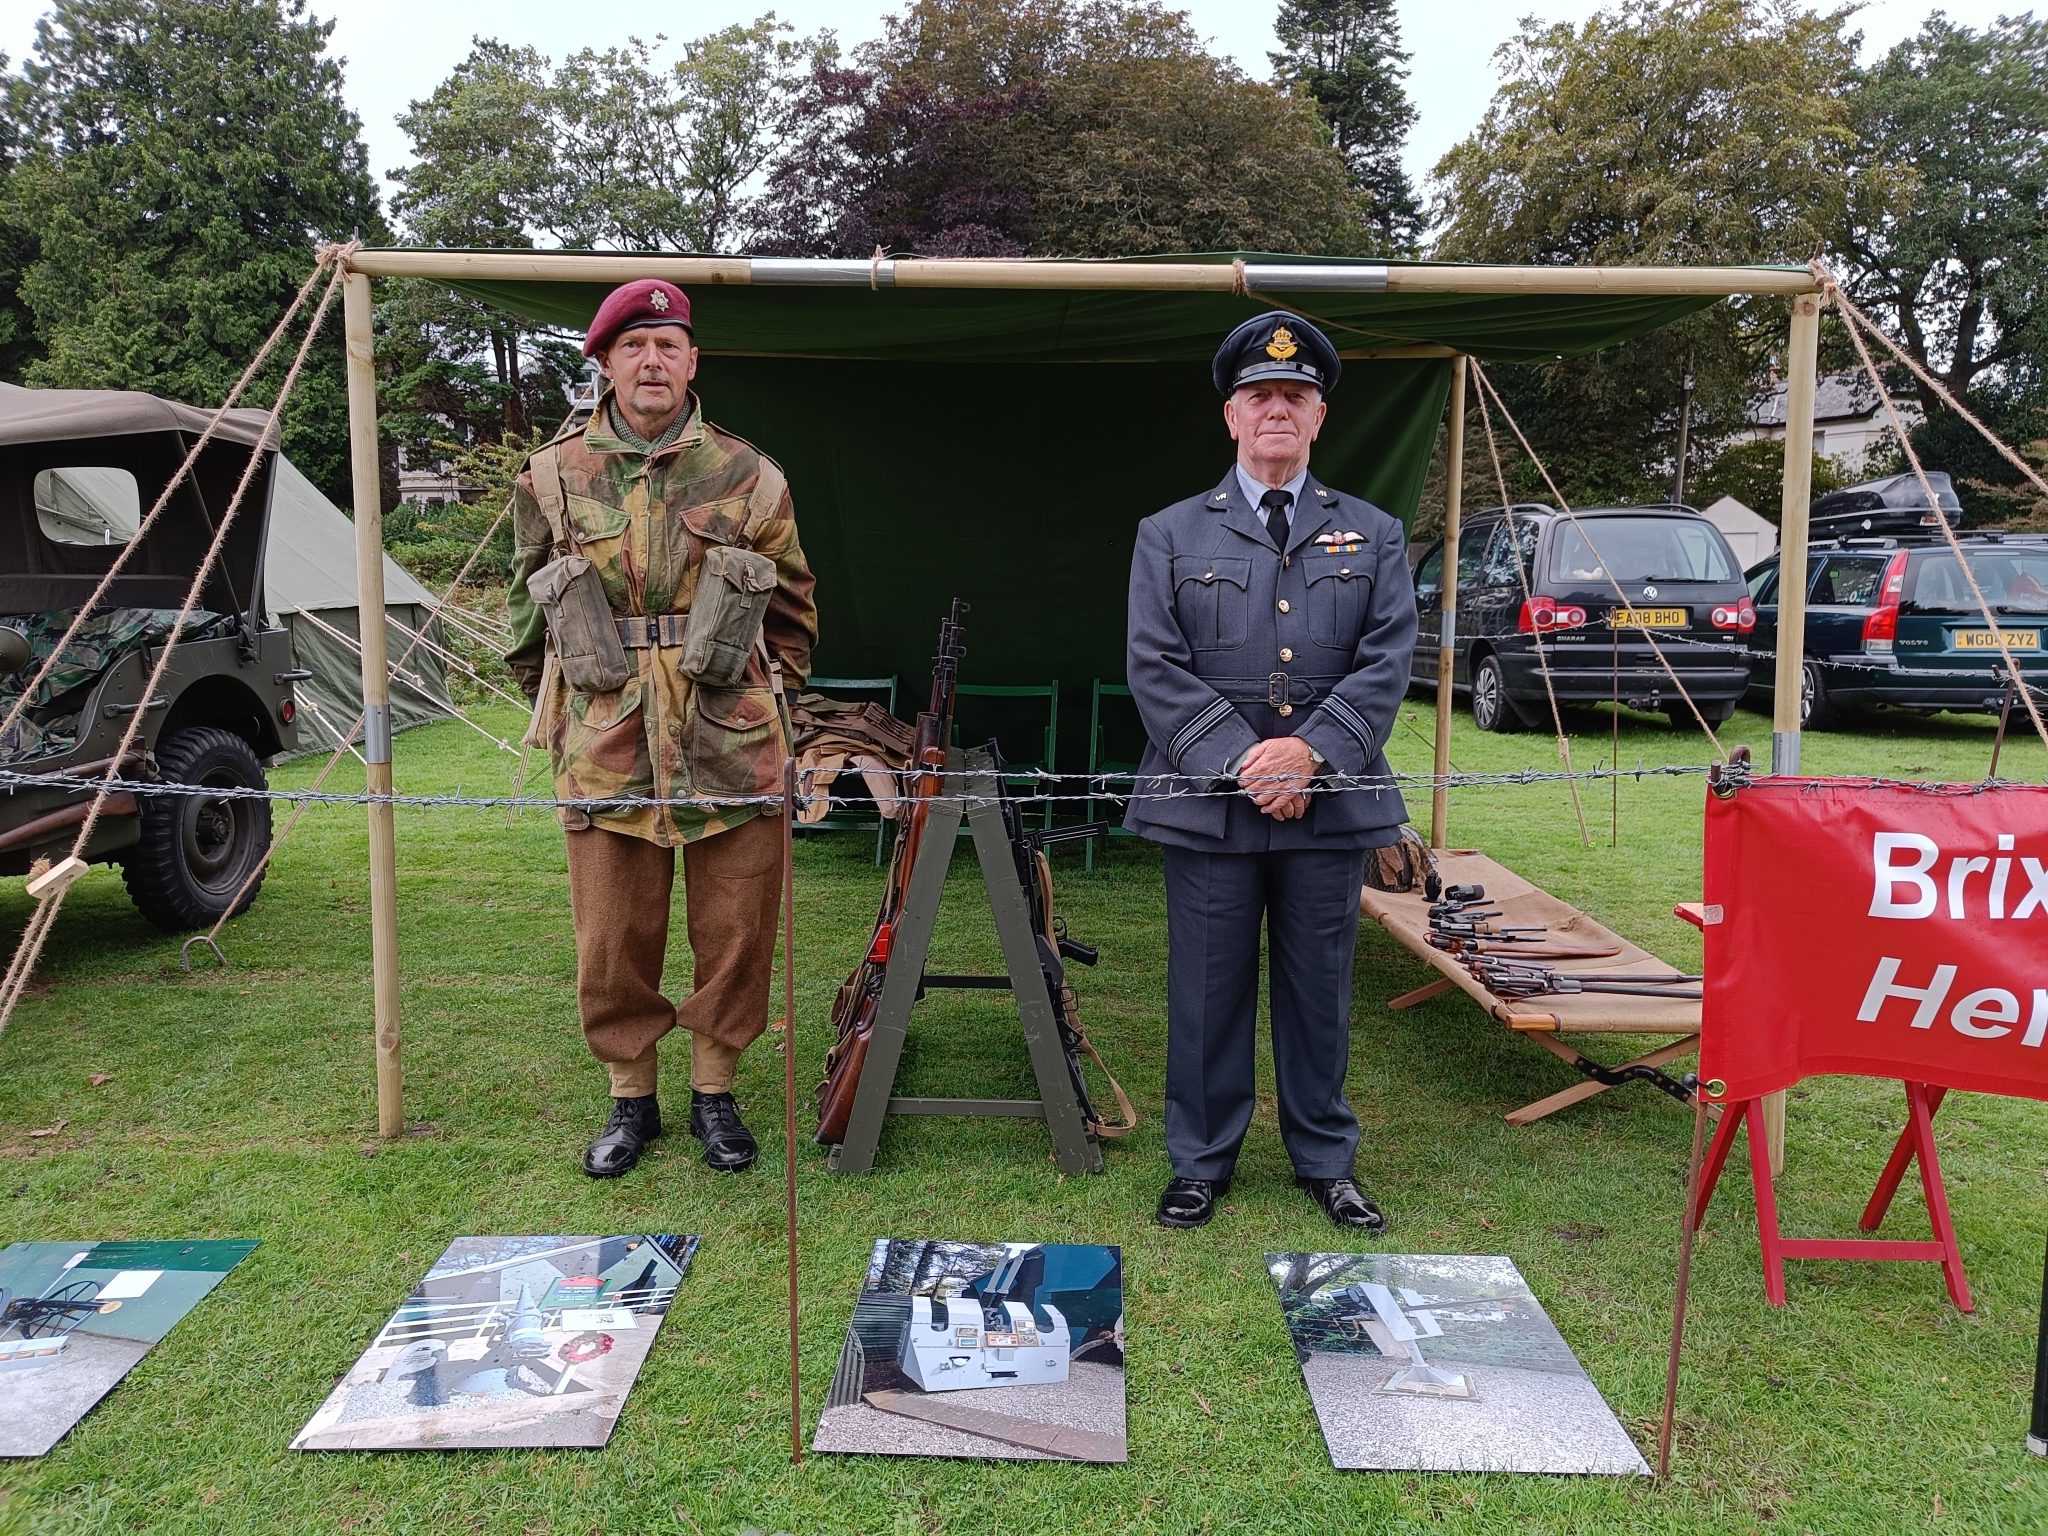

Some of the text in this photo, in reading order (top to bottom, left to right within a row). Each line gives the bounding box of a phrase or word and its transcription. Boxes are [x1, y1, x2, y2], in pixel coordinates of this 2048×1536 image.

[1655, 612, 1680, 624] BHO
[2006, 633, 2035, 646] ZYZ
[1867, 831, 2048, 920] Brix
